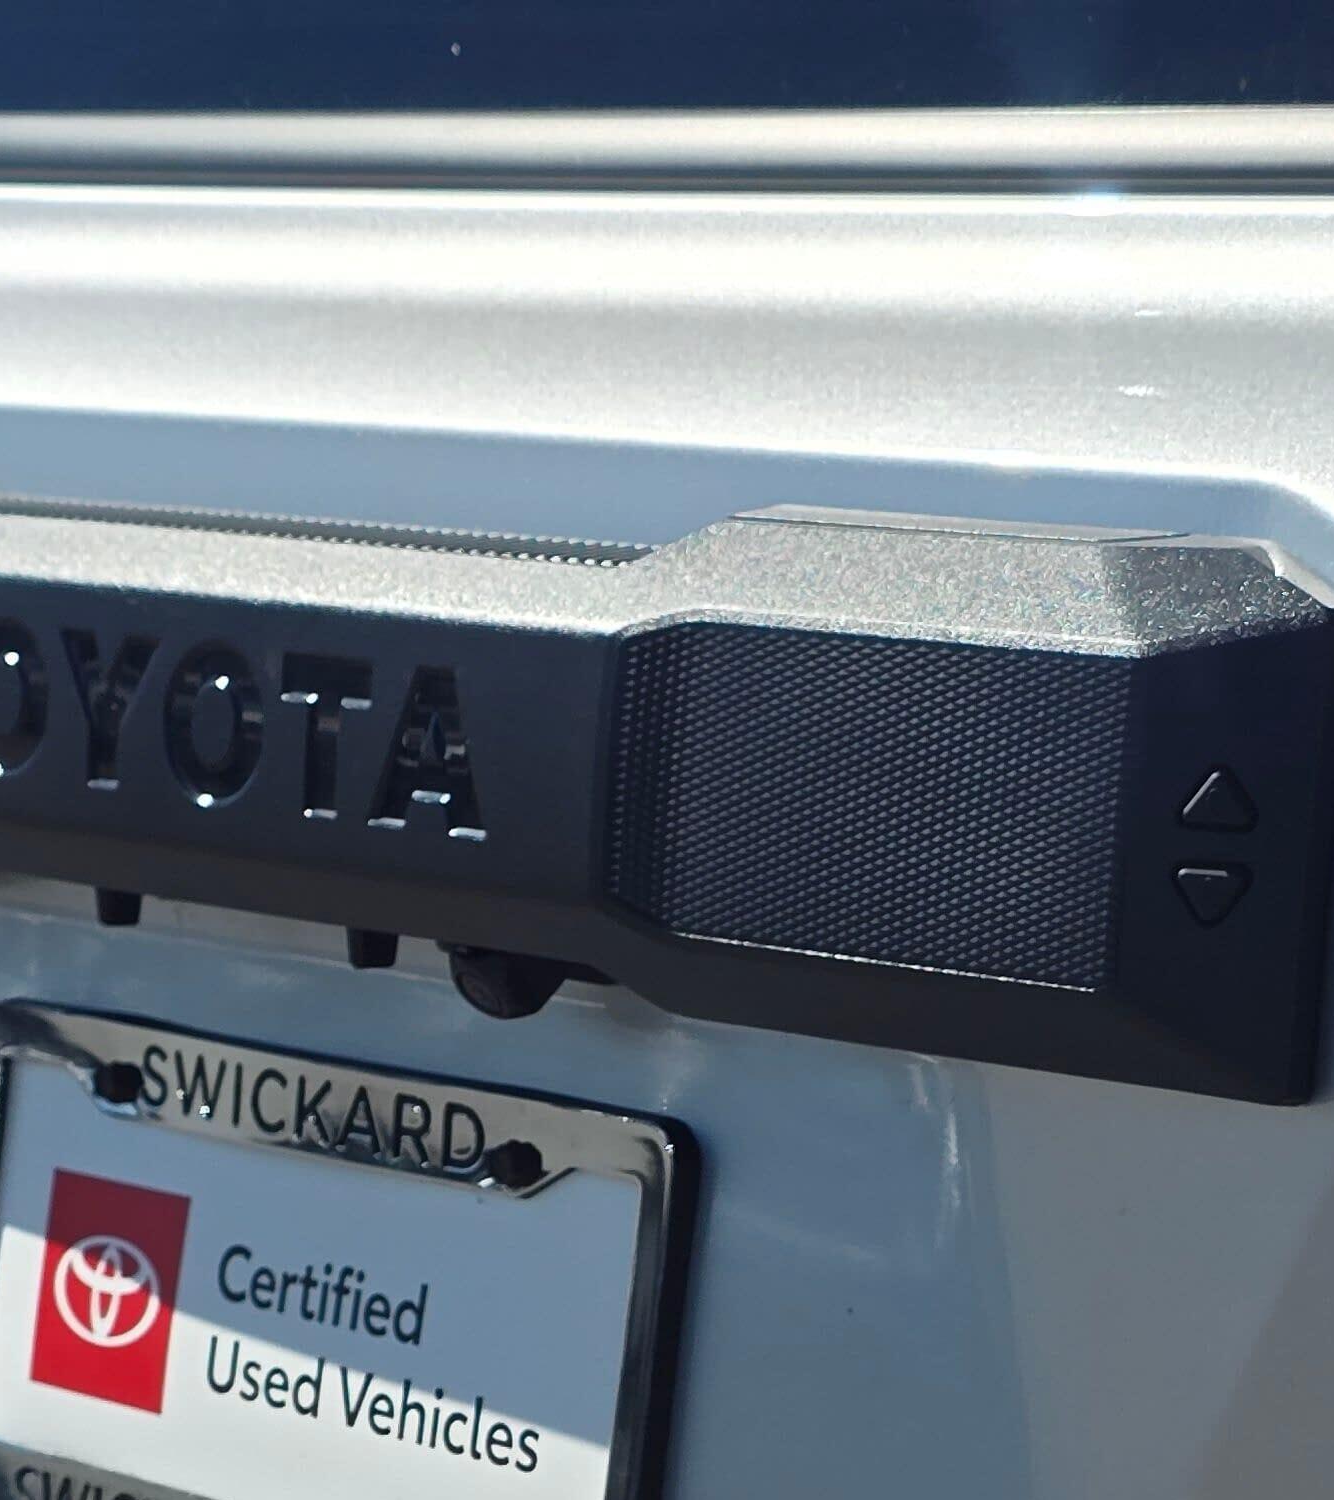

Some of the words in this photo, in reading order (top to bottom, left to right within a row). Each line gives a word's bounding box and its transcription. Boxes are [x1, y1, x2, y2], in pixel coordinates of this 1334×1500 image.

[140, 1044, 487, 1172] SWICKARD
[218, 1244, 428, 1346] Certified
[206, 1336, 325, 1417] Used
[339, 1365, 540, 1473] Vehicles
